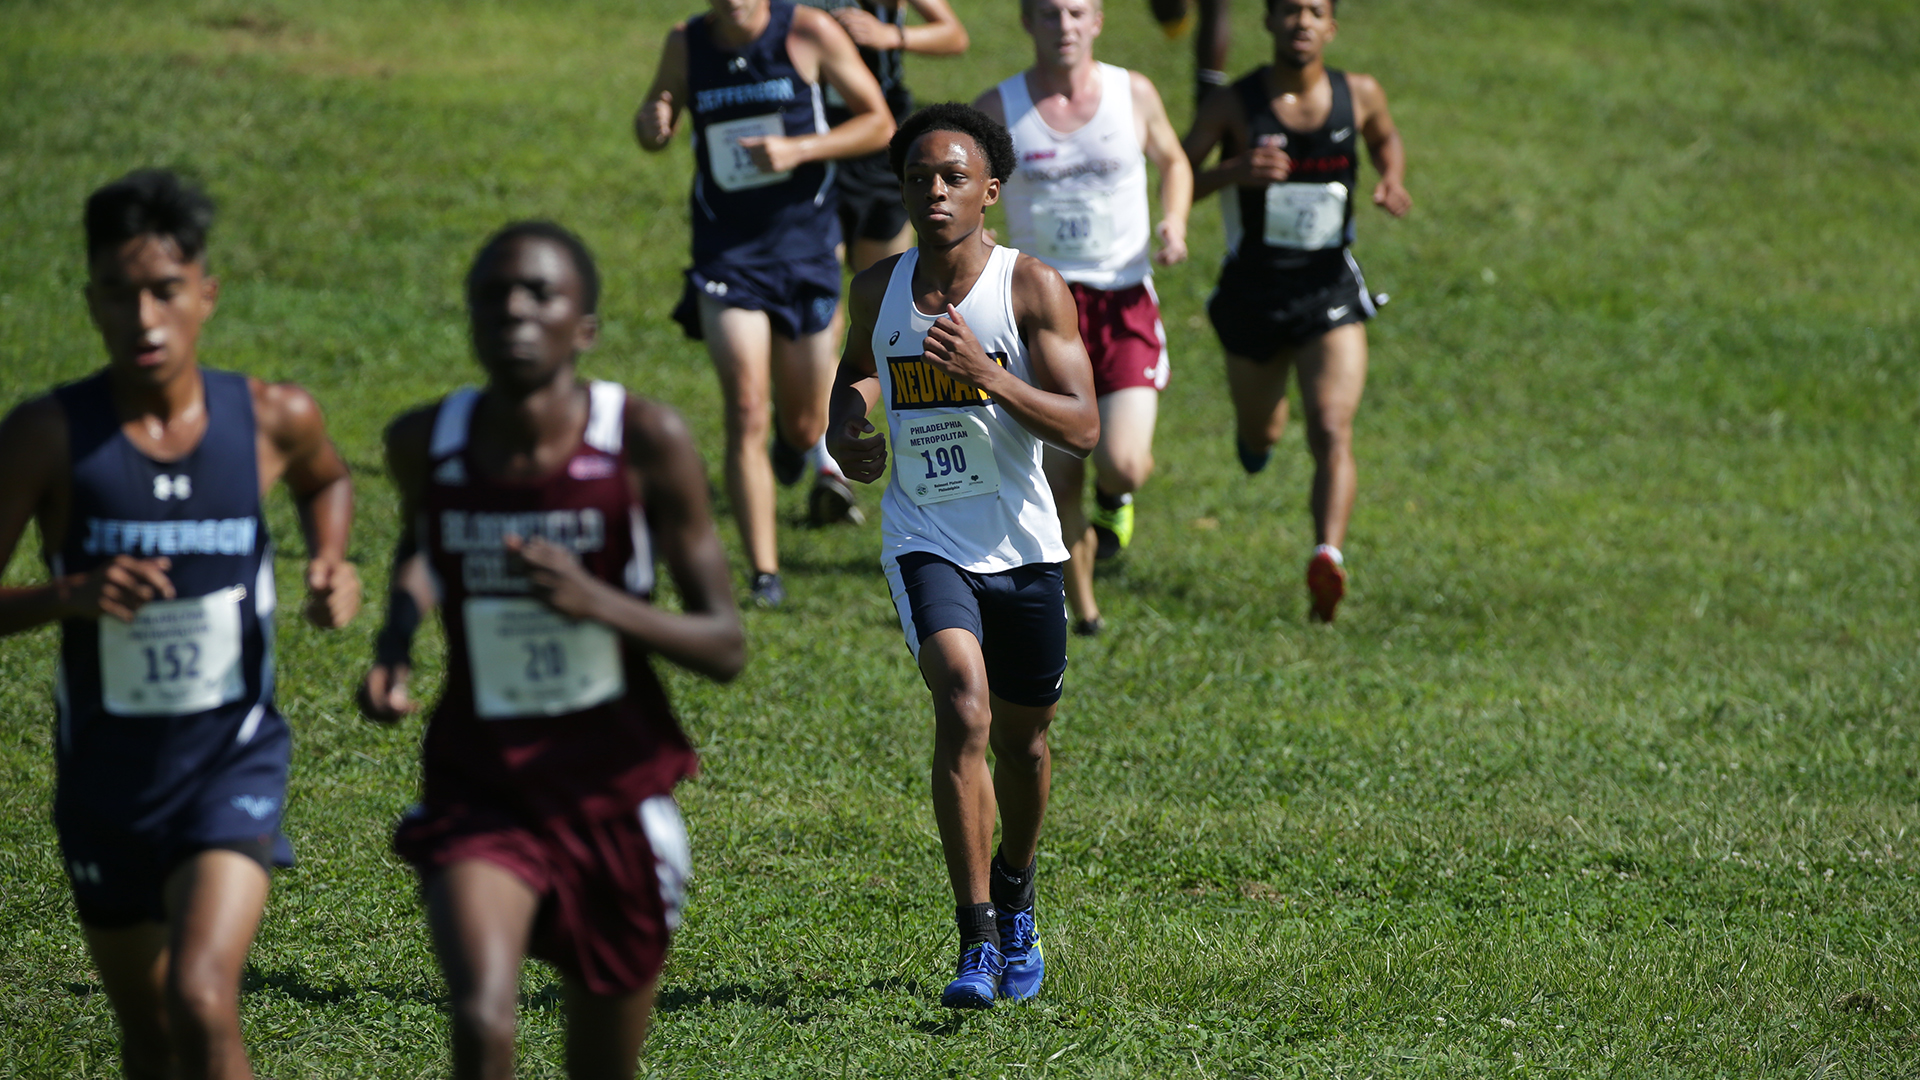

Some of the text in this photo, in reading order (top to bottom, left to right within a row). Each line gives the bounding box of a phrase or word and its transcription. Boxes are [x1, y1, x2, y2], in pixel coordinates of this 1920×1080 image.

[695, 76, 796, 113] JEFFERSON
[890, 356, 1004, 404] NEUMA
[910, 420, 963, 435] PHILADELPHIA
[910, 430, 969, 447] METROPOLITAN
[921, 444, 967, 479] 190
[83, 516, 258, 556] JEFFERSON
[142, 642, 201, 684] 152
